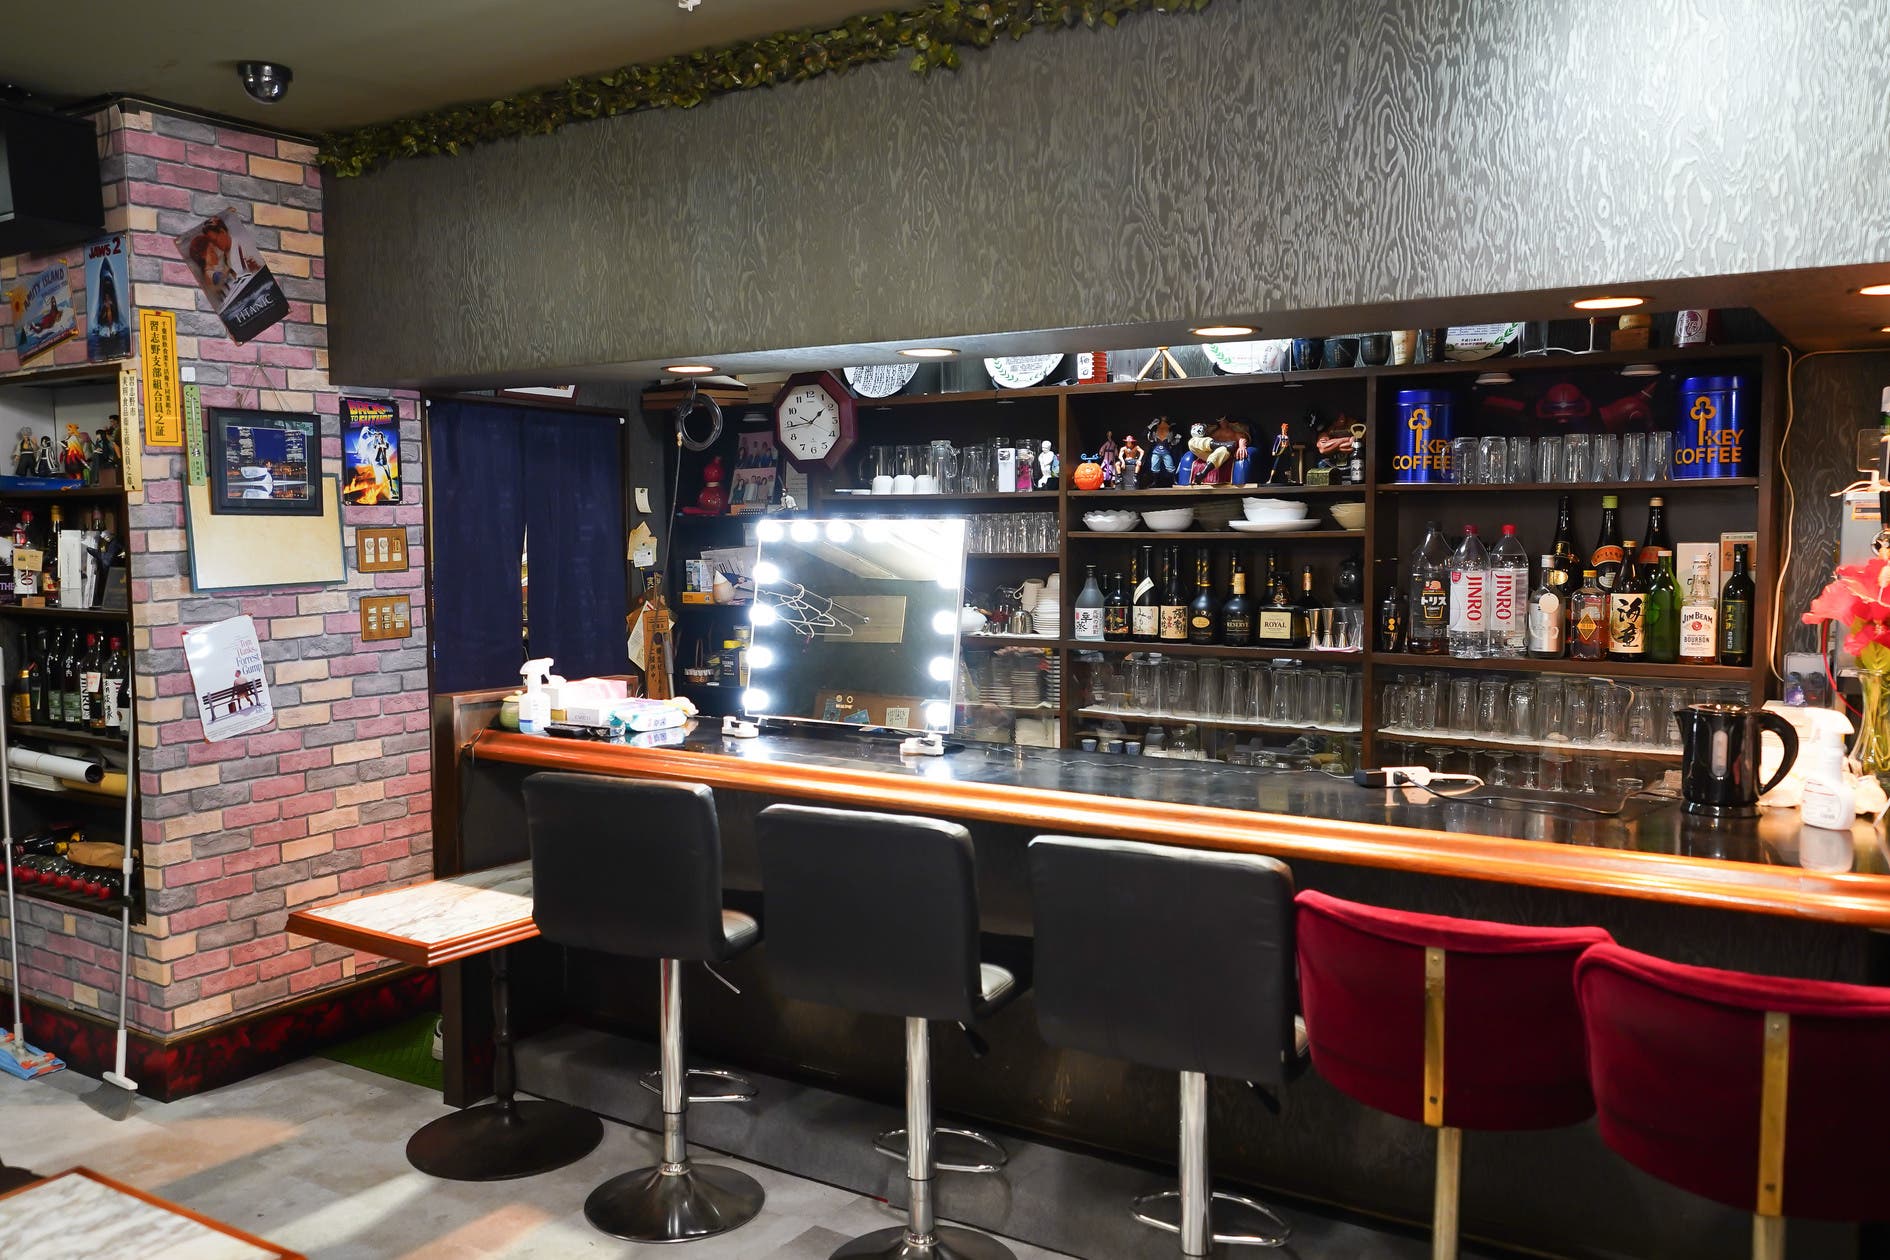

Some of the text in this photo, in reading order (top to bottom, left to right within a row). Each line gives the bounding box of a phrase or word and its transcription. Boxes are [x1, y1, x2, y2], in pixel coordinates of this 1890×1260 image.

[89, 236, 121, 259] JAWS 2
[41, 267, 65, 291] ISLAND
[235, 293, 274, 323] TITANIC
[149, 320, 166, 437] 習志野支部組合員之証
[788, 407, 797, 415] 10
[1705, 429, 1744, 446] KEY
[821, 442, 828, 450] 5
[1675, 447, 1742, 465] COFFEE
[1420, 596, 1447, 606] トリス
[1466, 575, 1482, 621] JINRO
[1495, 573, 1512, 620] JINRO
[1264, 621, 1287, 629] ROYAL
[1682, 611, 1713, 624] JIM BEAM
[236, 647, 257, 657] Hanks
[236, 655, 260, 668] Forrest
[242, 662, 263, 676] Gump
